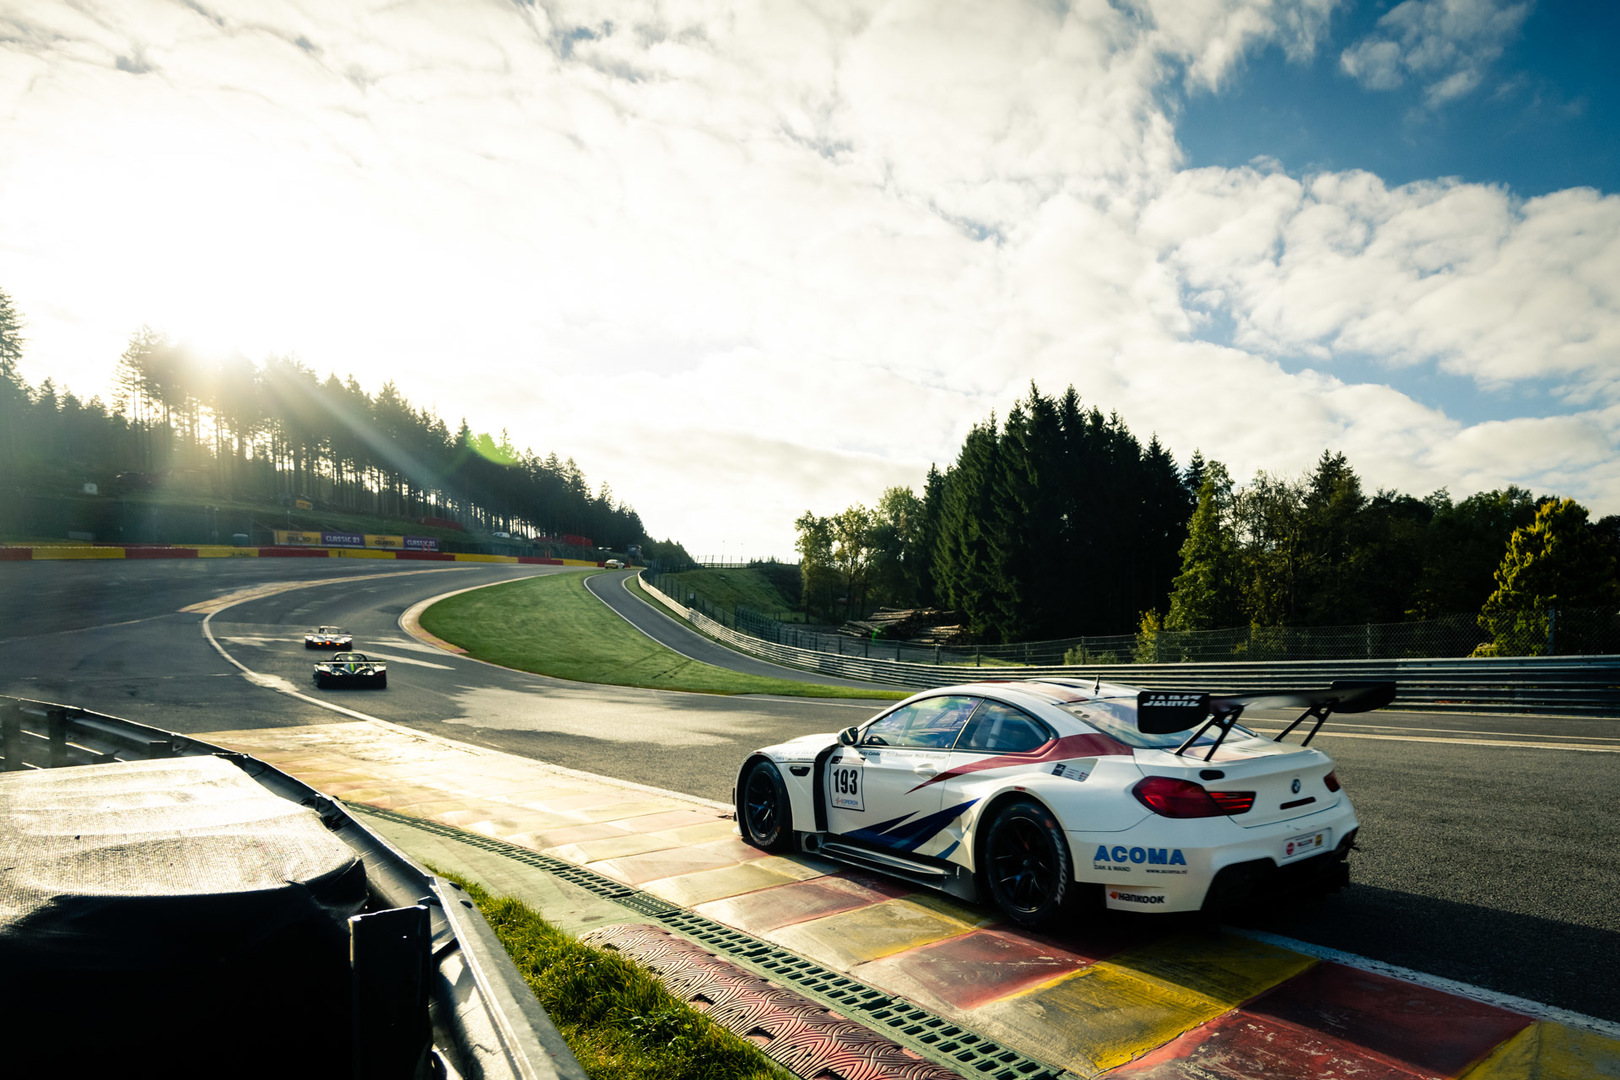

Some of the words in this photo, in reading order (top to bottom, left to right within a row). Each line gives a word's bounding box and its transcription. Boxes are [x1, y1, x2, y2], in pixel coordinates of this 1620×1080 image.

[325, 535, 352, 543] CLASSIC
[1142, 695, 1202, 707] JAIMZ
[833, 768, 858, 795] 193
[1094, 845, 1187, 866] ACOMA
